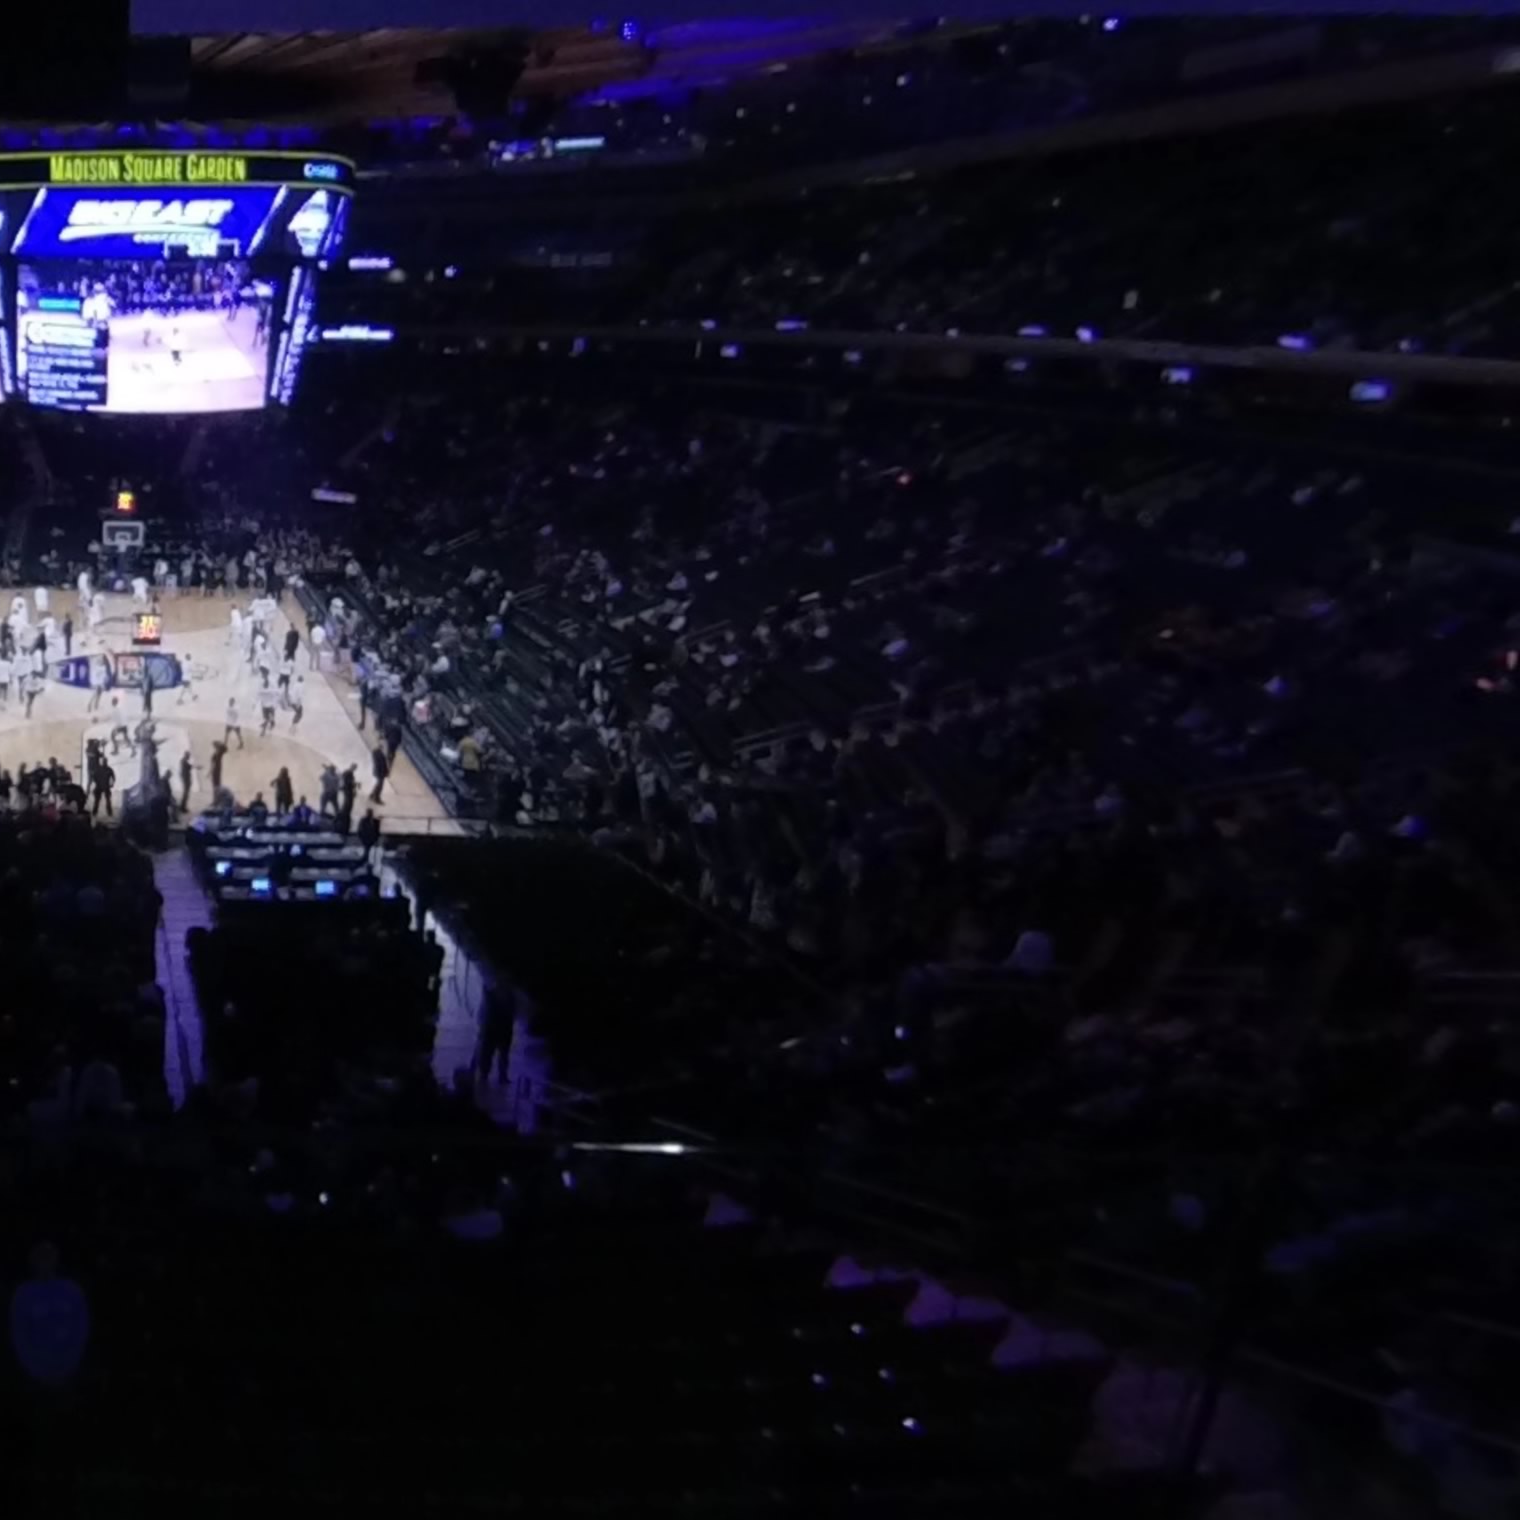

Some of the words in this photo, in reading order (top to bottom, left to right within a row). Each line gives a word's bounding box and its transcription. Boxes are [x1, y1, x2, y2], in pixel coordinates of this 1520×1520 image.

[50, 155, 120, 181] MADISON
[123, 154, 182, 181] SQUARE
[186, 153, 246, 181] GARDEN
